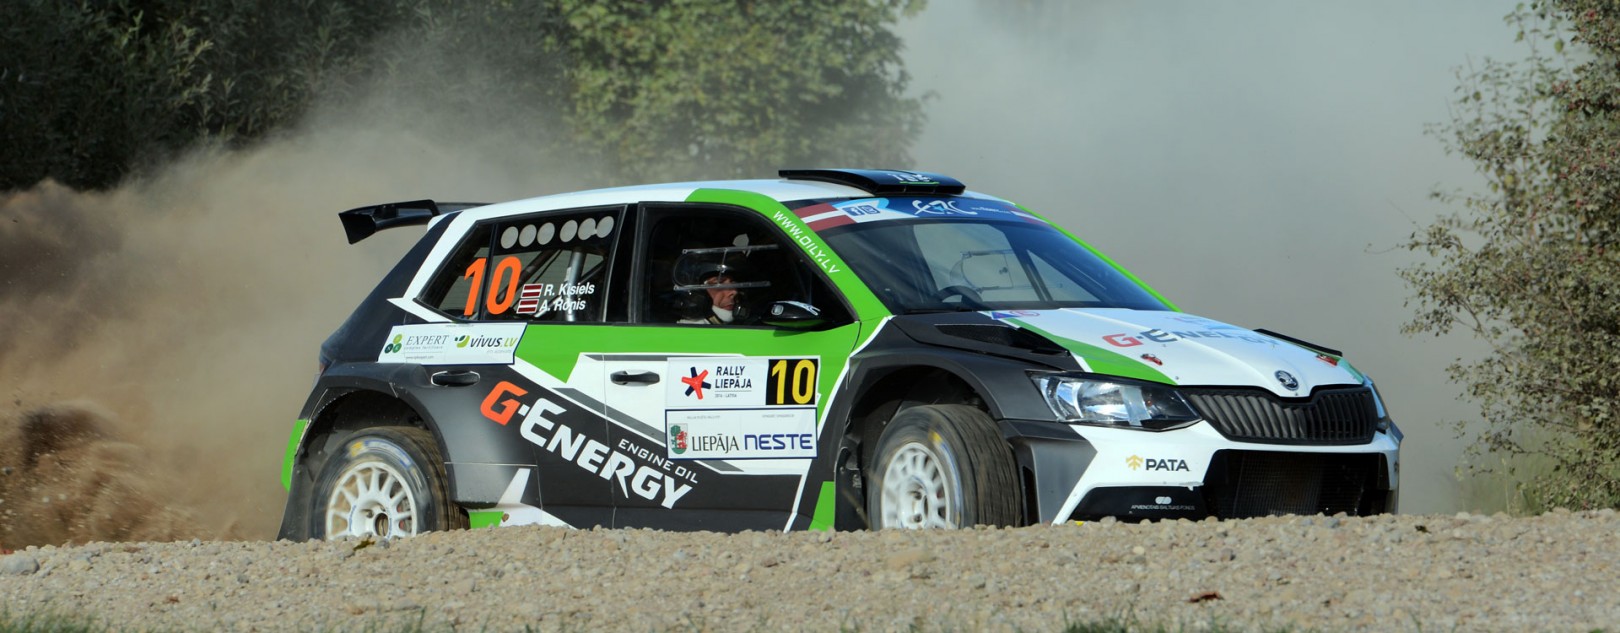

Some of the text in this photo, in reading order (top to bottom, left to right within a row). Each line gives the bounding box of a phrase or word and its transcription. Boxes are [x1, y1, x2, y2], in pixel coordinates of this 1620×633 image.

[773, 210, 840, 273] WWW.OILY.LV
[463, 255, 523, 316] 10
[543, 282, 595, 296] R. Kisiels
[539, 299, 551, 312] A.
[406, 334, 449, 346] EXPERT
[716, 365, 746, 376] RALLY
[715, 376, 752, 389] LIEPĀJA
[771, 359, 816, 405] 10
[480, 380, 693, 510] G-ENERGY
[692, 433, 739, 454] LIEPĀJA
[744, 433, 813, 451] NESTE
[618, 438, 698, 484] ENGINE OIL
[1145, 458, 1190, 471] PATA
